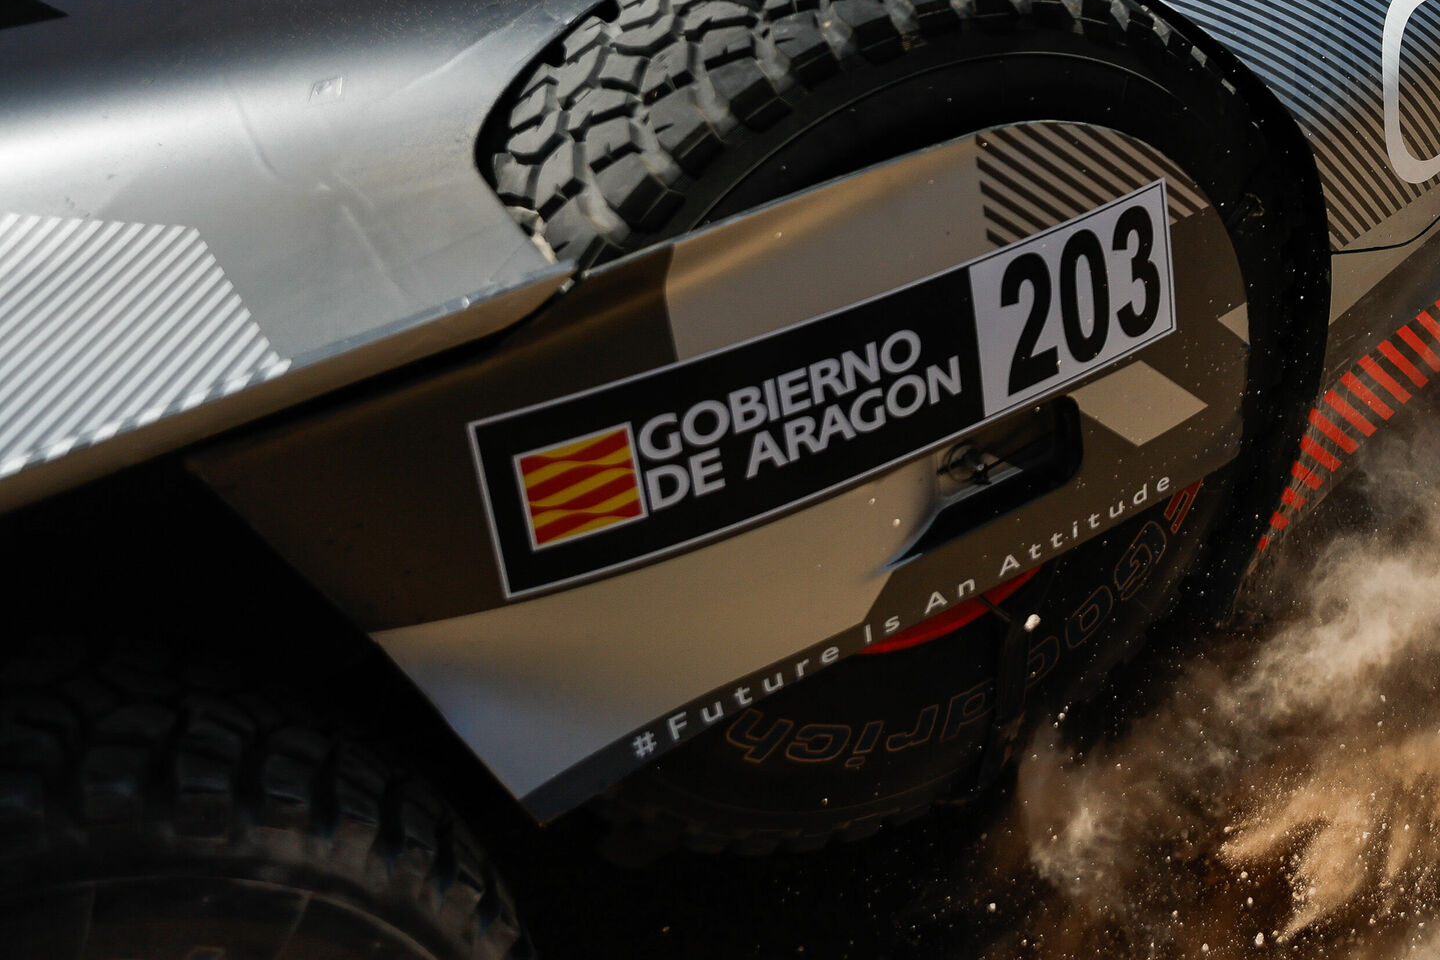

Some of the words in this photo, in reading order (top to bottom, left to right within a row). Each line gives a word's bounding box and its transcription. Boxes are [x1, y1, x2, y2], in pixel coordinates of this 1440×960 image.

[1000, 204, 1161, 397] 203
[638, 328, 922, 461] GOBIERNO
[646, 448, 726, 512] DE
[744, 355, 963, 479] ARAGON
[864, 615, 901, 644] Is
[924, 577, 977, 616] An
[998, 474, 1172, 578] Attitude
